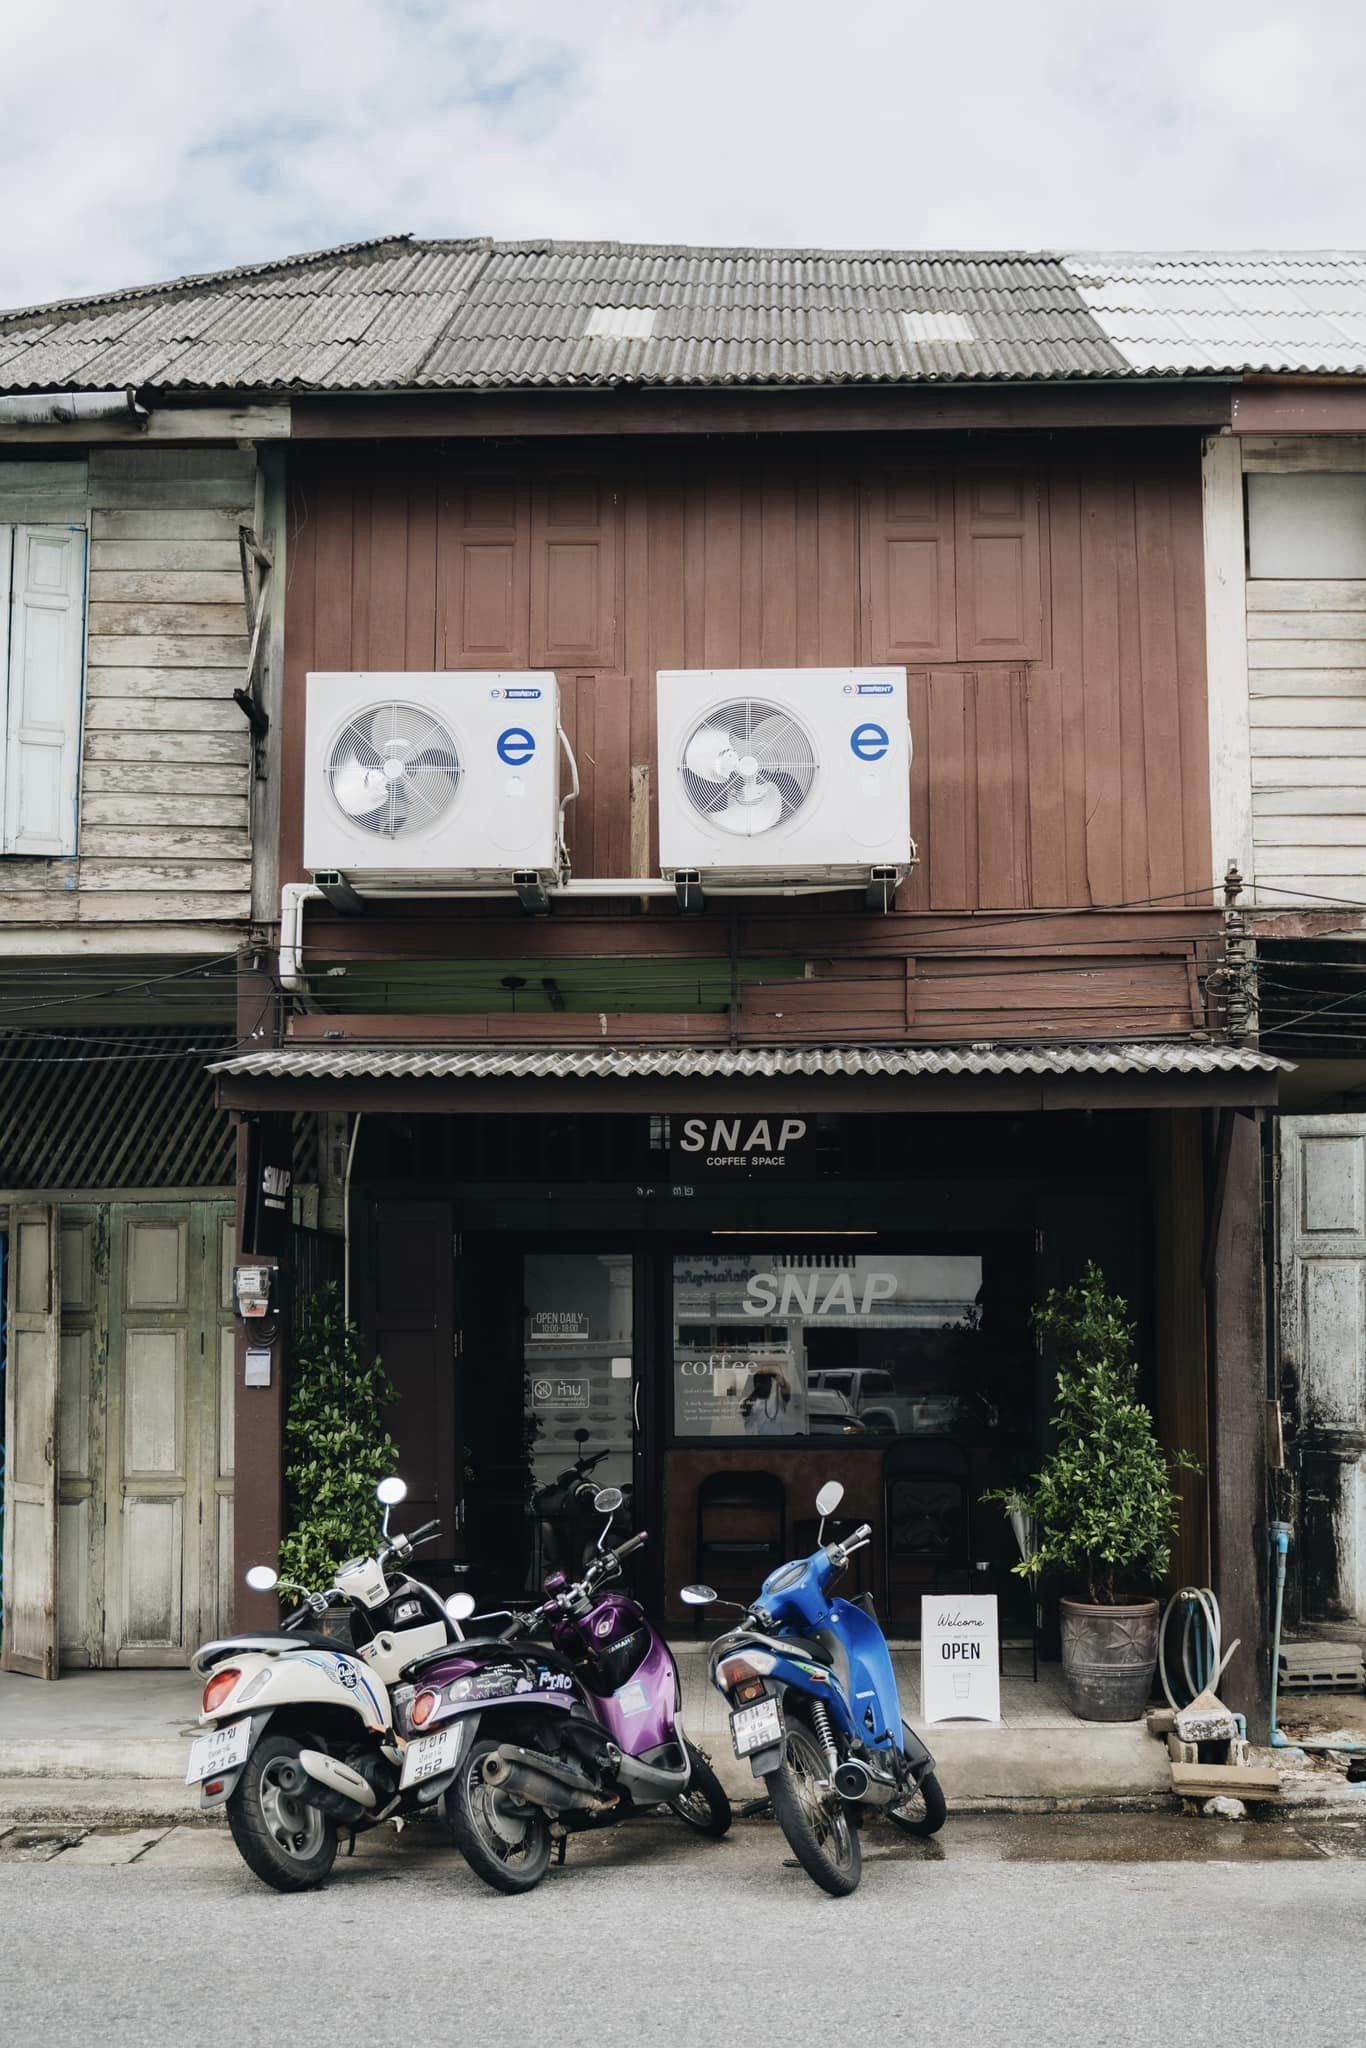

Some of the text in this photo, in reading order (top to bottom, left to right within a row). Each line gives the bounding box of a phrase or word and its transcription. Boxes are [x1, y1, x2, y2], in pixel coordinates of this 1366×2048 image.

[680, 1119, 807, 1152] SNAP
[706, 1157, 785, 1166] COFFEE SPACE
[742, 1273, 898, 1316] SNAP
[536, 1312, 583, 1324] OPEN DAILY
[681, 1354, 760, 1376] coffee
[937, 1611, 985, 1627] Welcome
[941, 1642, 981, 1660] OPEN
[414, 1758, 443, 1779] 352
